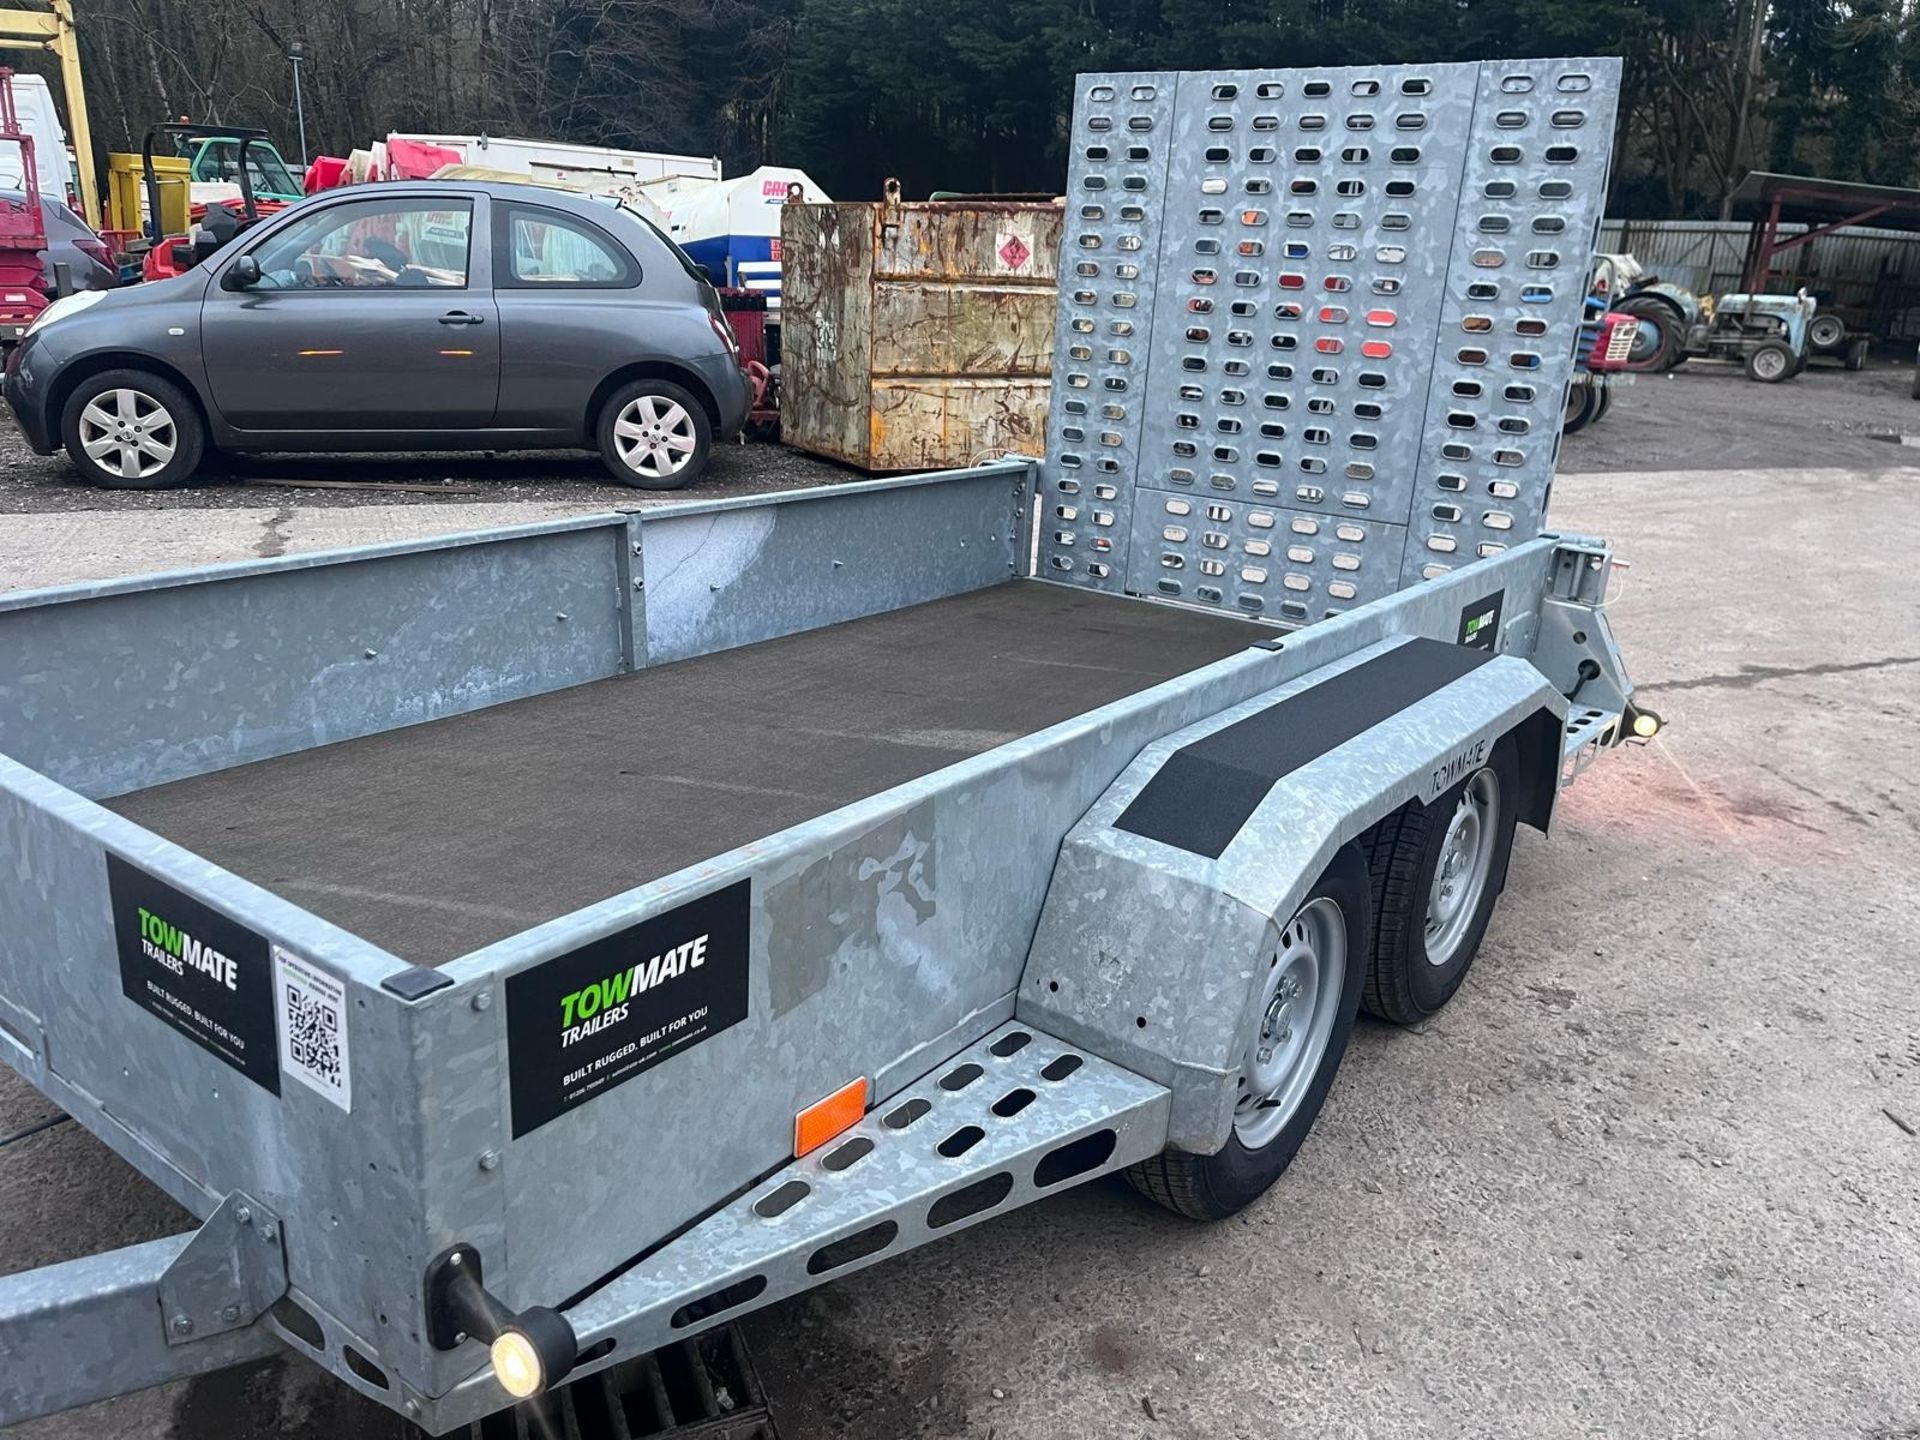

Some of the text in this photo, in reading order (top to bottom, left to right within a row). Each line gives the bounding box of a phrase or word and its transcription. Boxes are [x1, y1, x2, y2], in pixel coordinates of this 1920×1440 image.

[1432, 739, 1485, 795] TOWMATE
[138, 907, 238, 991] TOWMATE
[142, 939, 184, 977] TRAILERS
[560, 934, 709, 1029] TOWMATE
[146, 980, 165, 998] BUILT
[194, 1010, 213, 1030] BUILT
[214, 1024, 230, 1040] FOR
[230, 1033, 246, 1050] YOU
[561, 1003, 629, 1049] TRAILERS
[563, 1063, 594, 1087] BUILT
[595, 1043, 638, 1071] RUGGED.
[640, 1026, 668, 1048] BUILT
[668, 1016, 688, 1035] FOR
[689, 1006, 709, 1025] YOU
